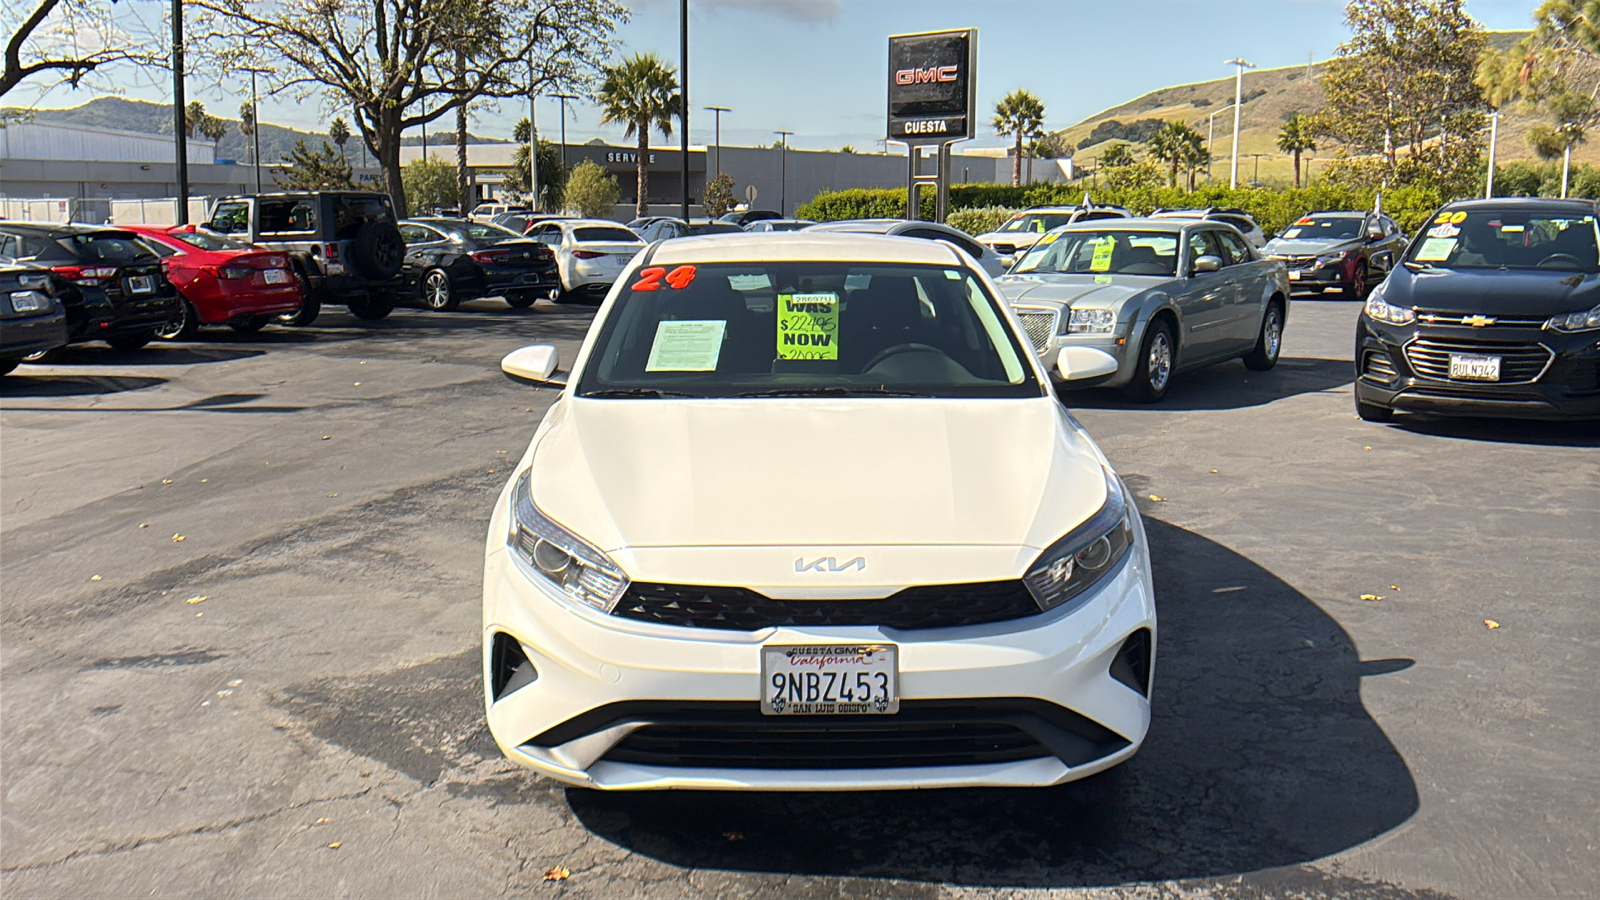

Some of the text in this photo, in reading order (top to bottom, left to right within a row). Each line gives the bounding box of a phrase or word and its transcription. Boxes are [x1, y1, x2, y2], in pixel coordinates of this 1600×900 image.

[896, 64, 958, 85] GMC
[904, 120, 947, 134] CUESTA
[607, 152, 655, 164] SERVE
[1434, 211, 1468, 225] 20
[631, 265, 696, 292] 24
[785, 300, 832, 313] WAS
[783, 333, 831, 347] NOW
[792, 647, 833, 655] CUESTA
[790, 654, 873, 670] California
[771, 671, 889, 703] 9NBZ453
[814, 702, 836, 713] LUIS
